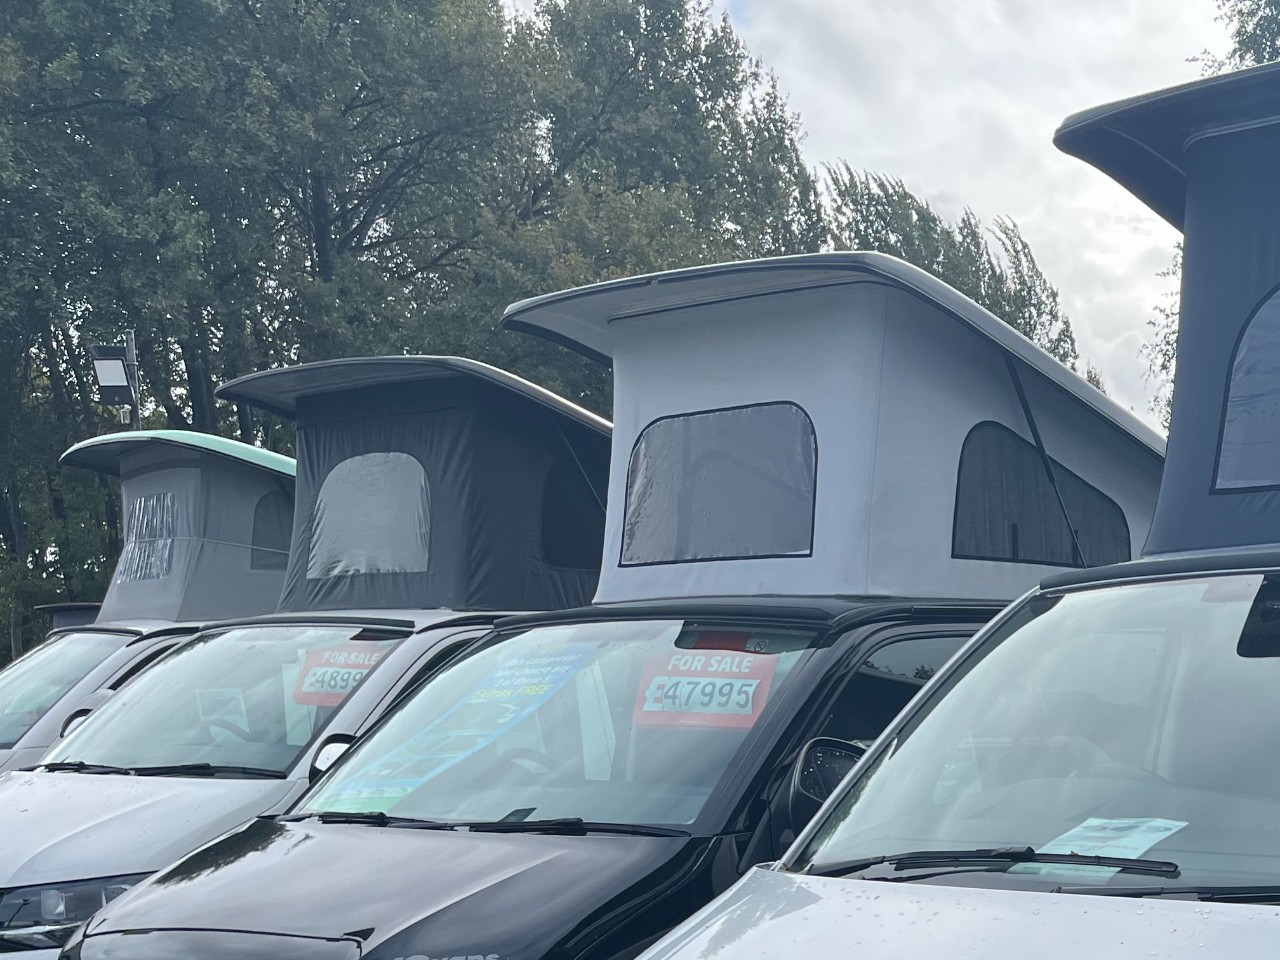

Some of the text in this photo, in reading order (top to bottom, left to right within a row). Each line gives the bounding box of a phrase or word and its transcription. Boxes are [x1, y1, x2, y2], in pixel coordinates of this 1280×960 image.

[322, 651, 380, 665] FOR SALE
[667, 655, 754, 673] FOR SALE
